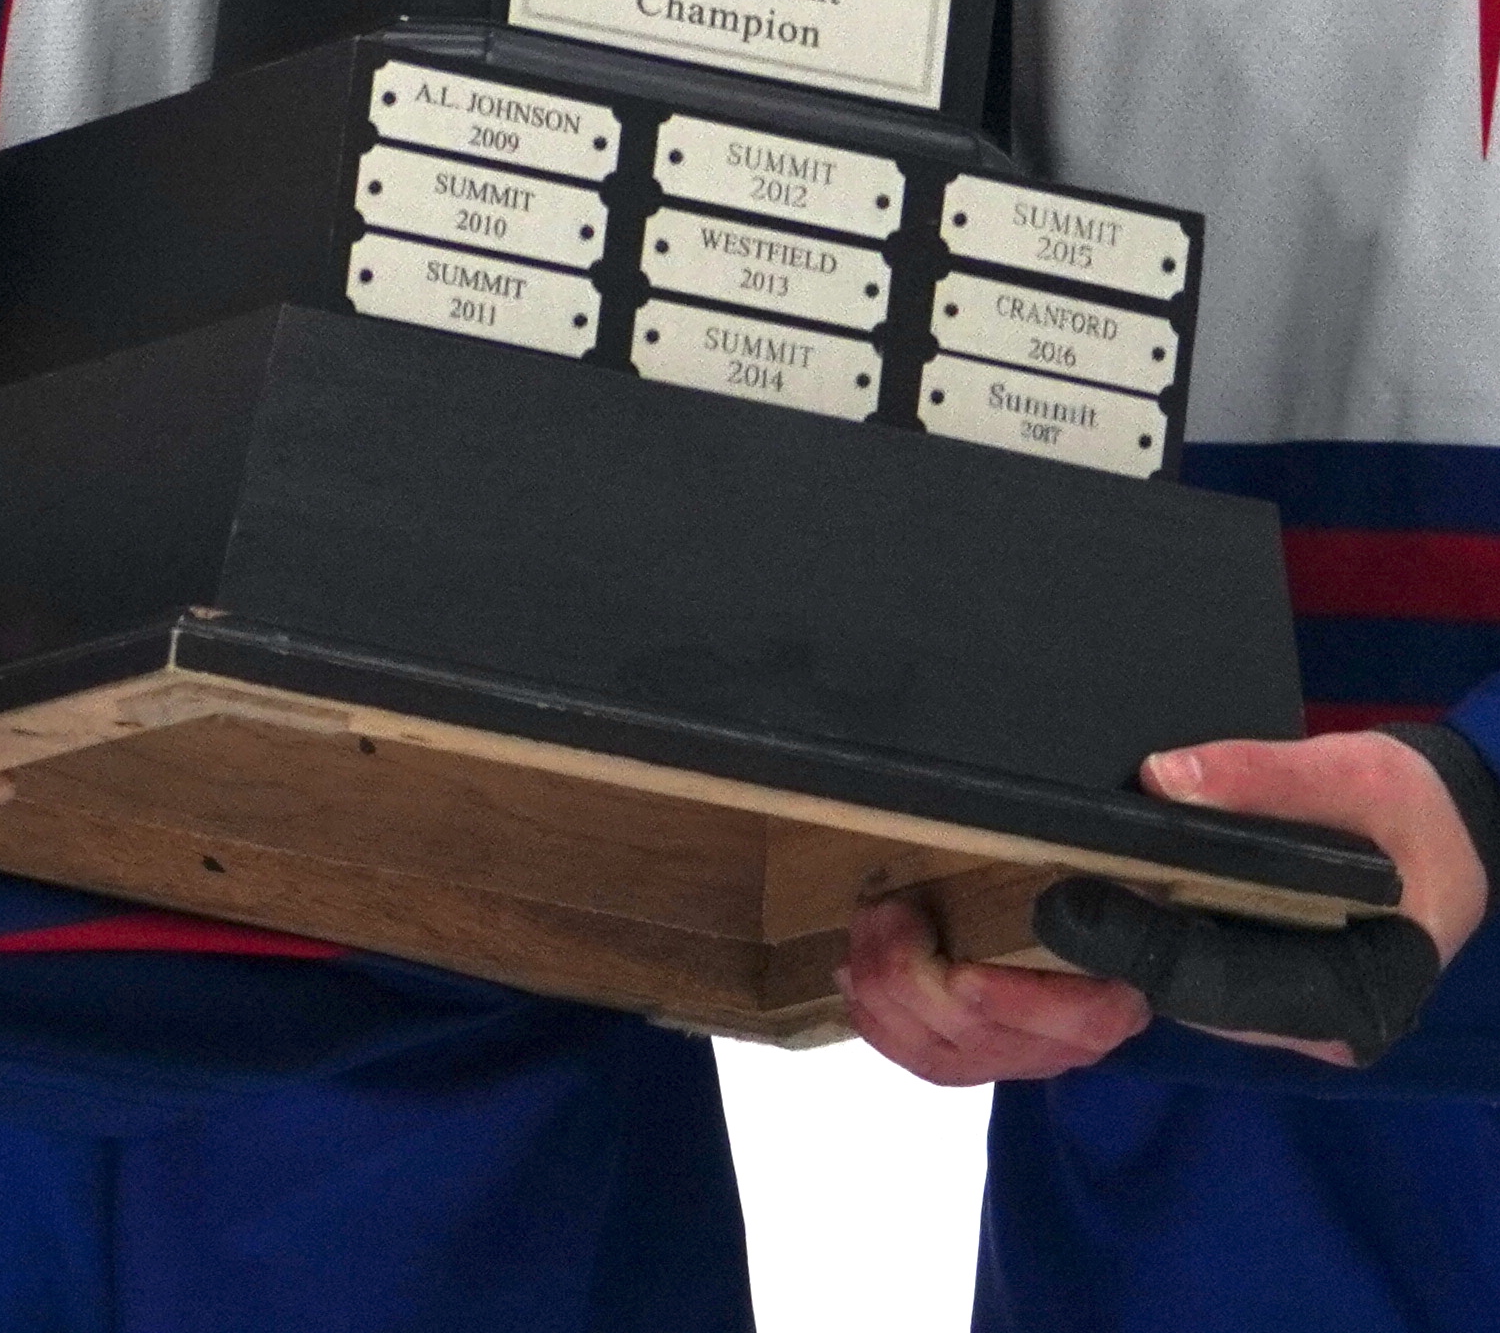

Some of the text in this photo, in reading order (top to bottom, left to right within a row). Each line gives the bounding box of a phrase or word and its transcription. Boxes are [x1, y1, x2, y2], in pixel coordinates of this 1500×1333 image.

[414, 83, 582, 134] A.L. JOHNSON
[467, 125, 521, 153] 2009
[725, 141, 837, 186] SUMMIT
[434, 172, 536, 212] SUMMIT
[749, 176, 809, 209] 2012
[455, 209, 508, 237] 2010
[1012, 201, 1123, 247] SUMMIT
[700, 227, 838, 275] WESTFIELD
[1035, 236, 1094, 269] 2015
[426, 259, 528, 299] SUMMIT
[739, 267, 790, 297] 2013
[449, 298, 497, 326] 2011
[995, 294, 1119, 341] CRANFORD
[703, 327, 815, 370] SUMMIT
[1027, 338, 1077, 369] 2016
[726, 360, 785, 393] 2014
[988, 382, 1100, 430] Summit
